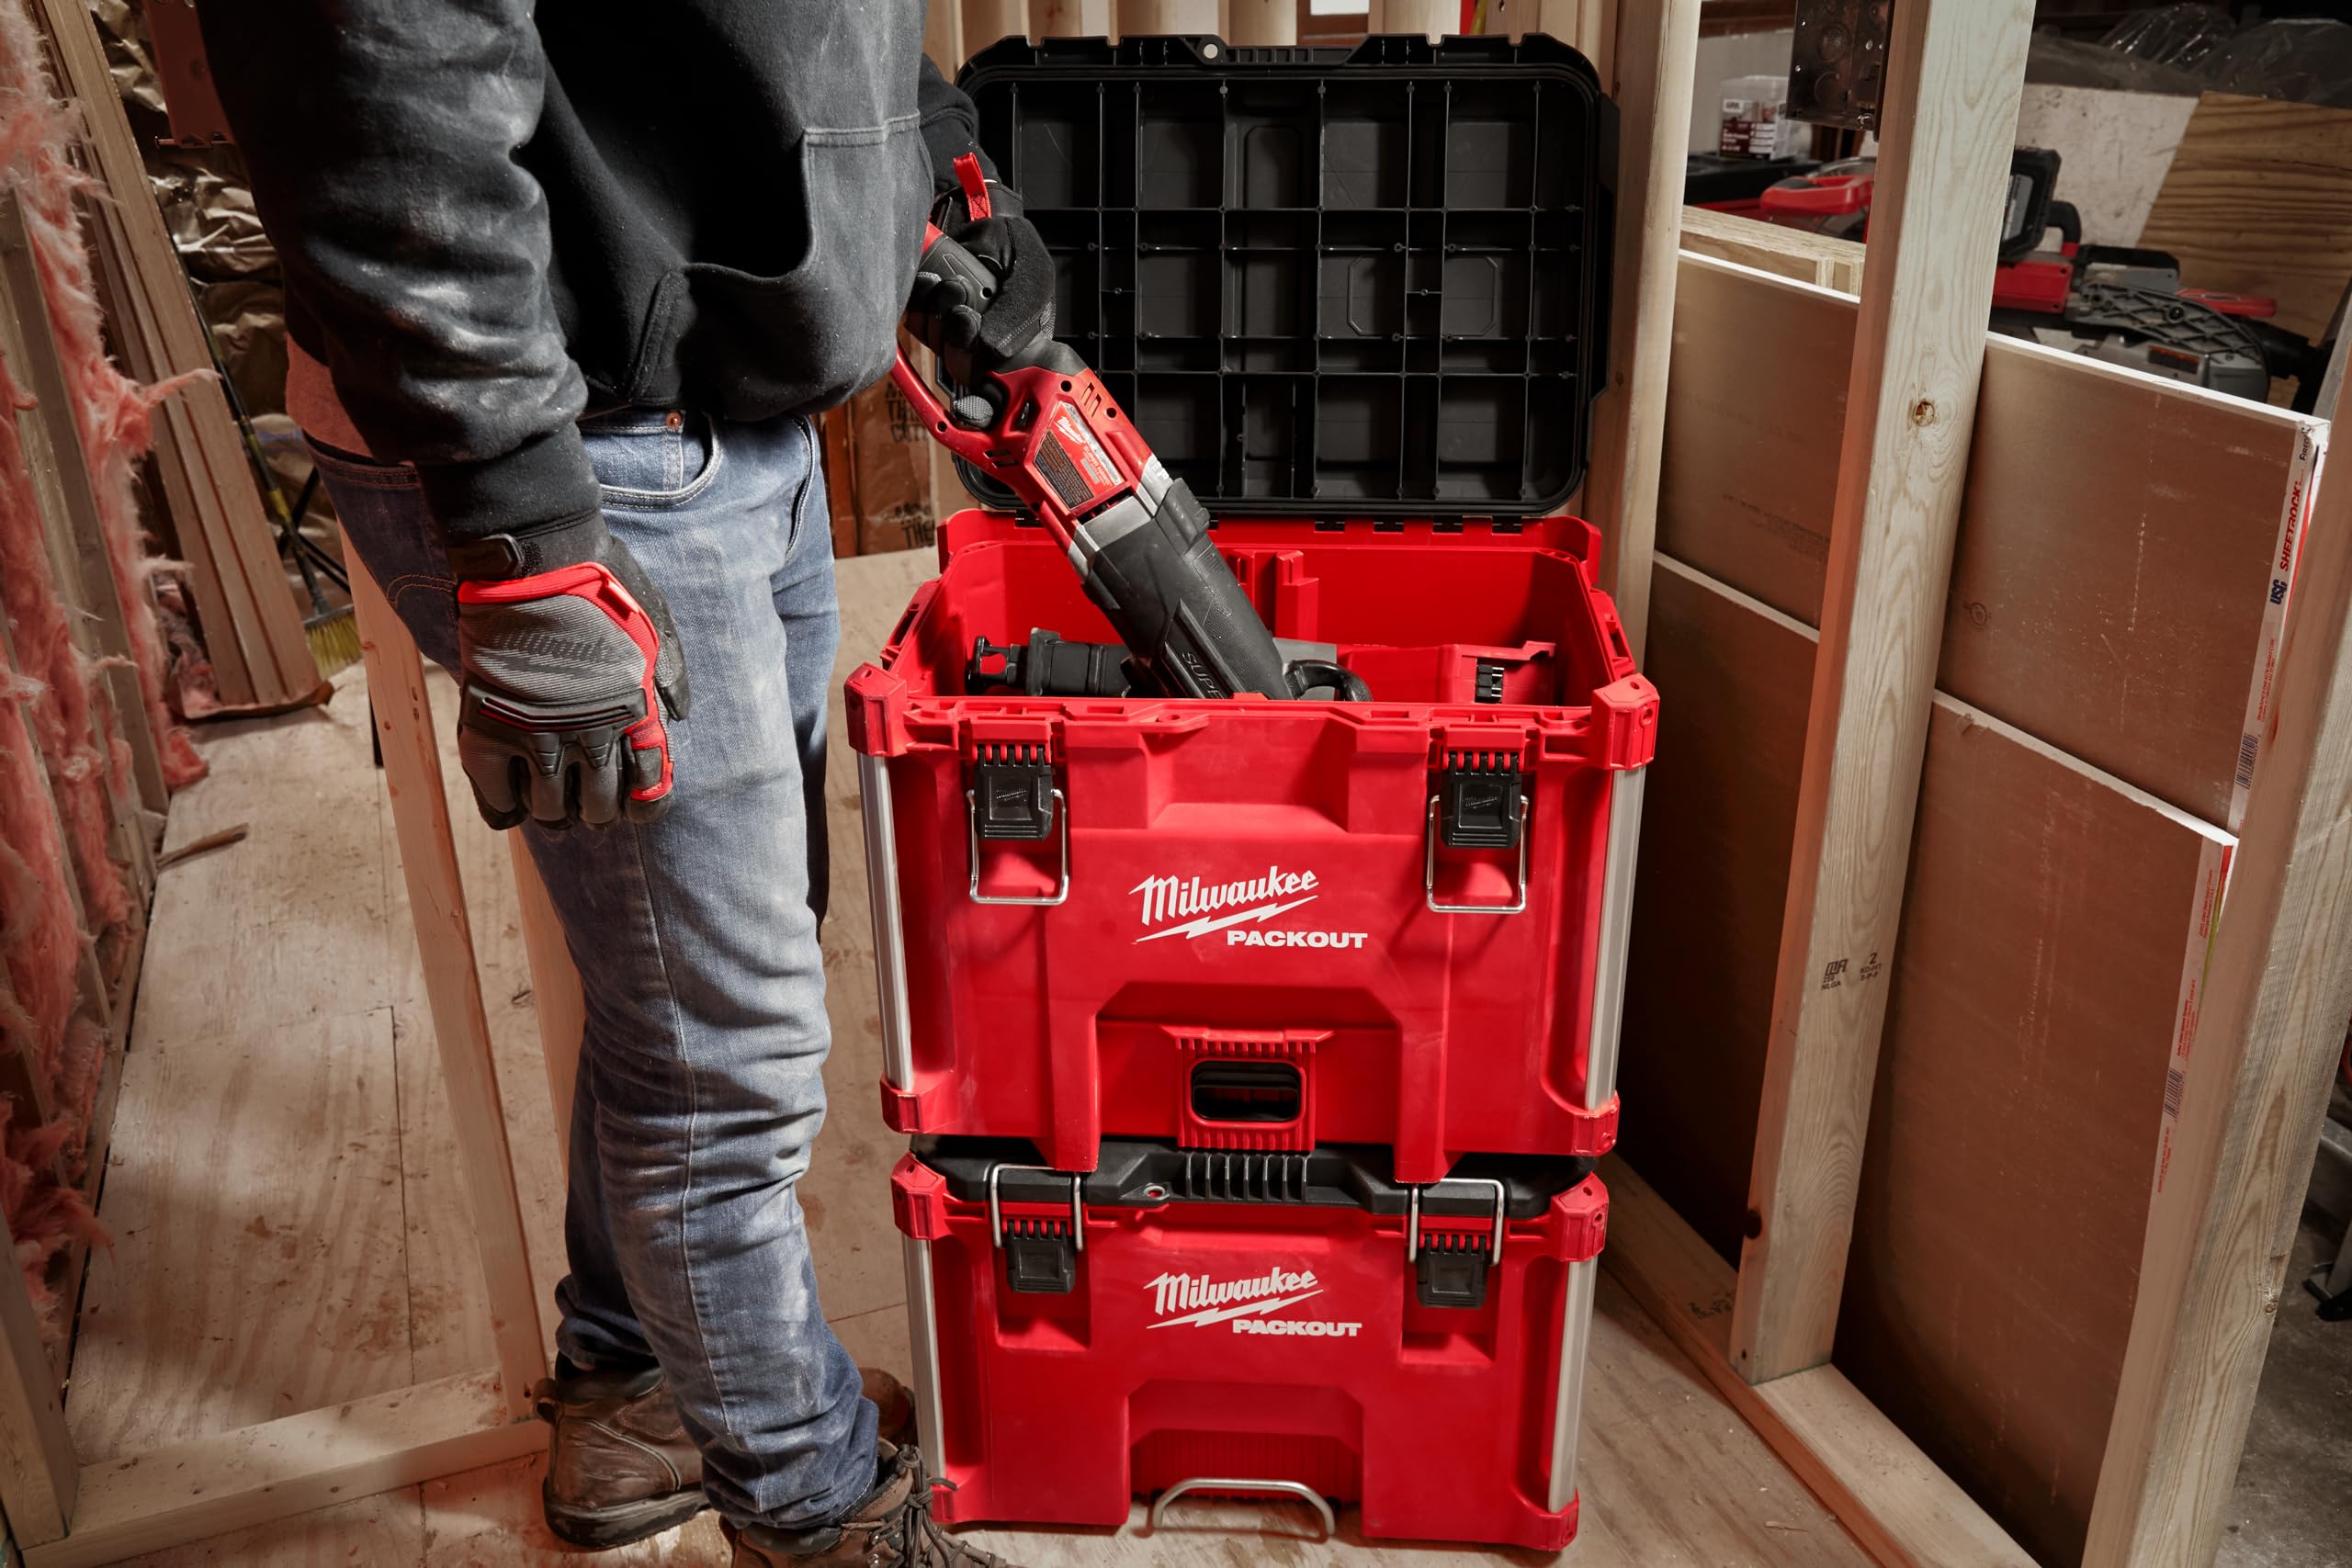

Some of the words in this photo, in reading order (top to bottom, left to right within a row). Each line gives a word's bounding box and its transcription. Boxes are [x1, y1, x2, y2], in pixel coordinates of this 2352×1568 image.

[2269, 579, 2288, 605] USG
[1128, 865, 1319, 926] Milwaukee
[1227, 930, 1368, 949] PACKOUT
[1869, 953, 1878, 964] 2
[1143, 1267, 1318, 1315] Milwaukee
[1232, 1319, 1363, 1337] PACKOUT
